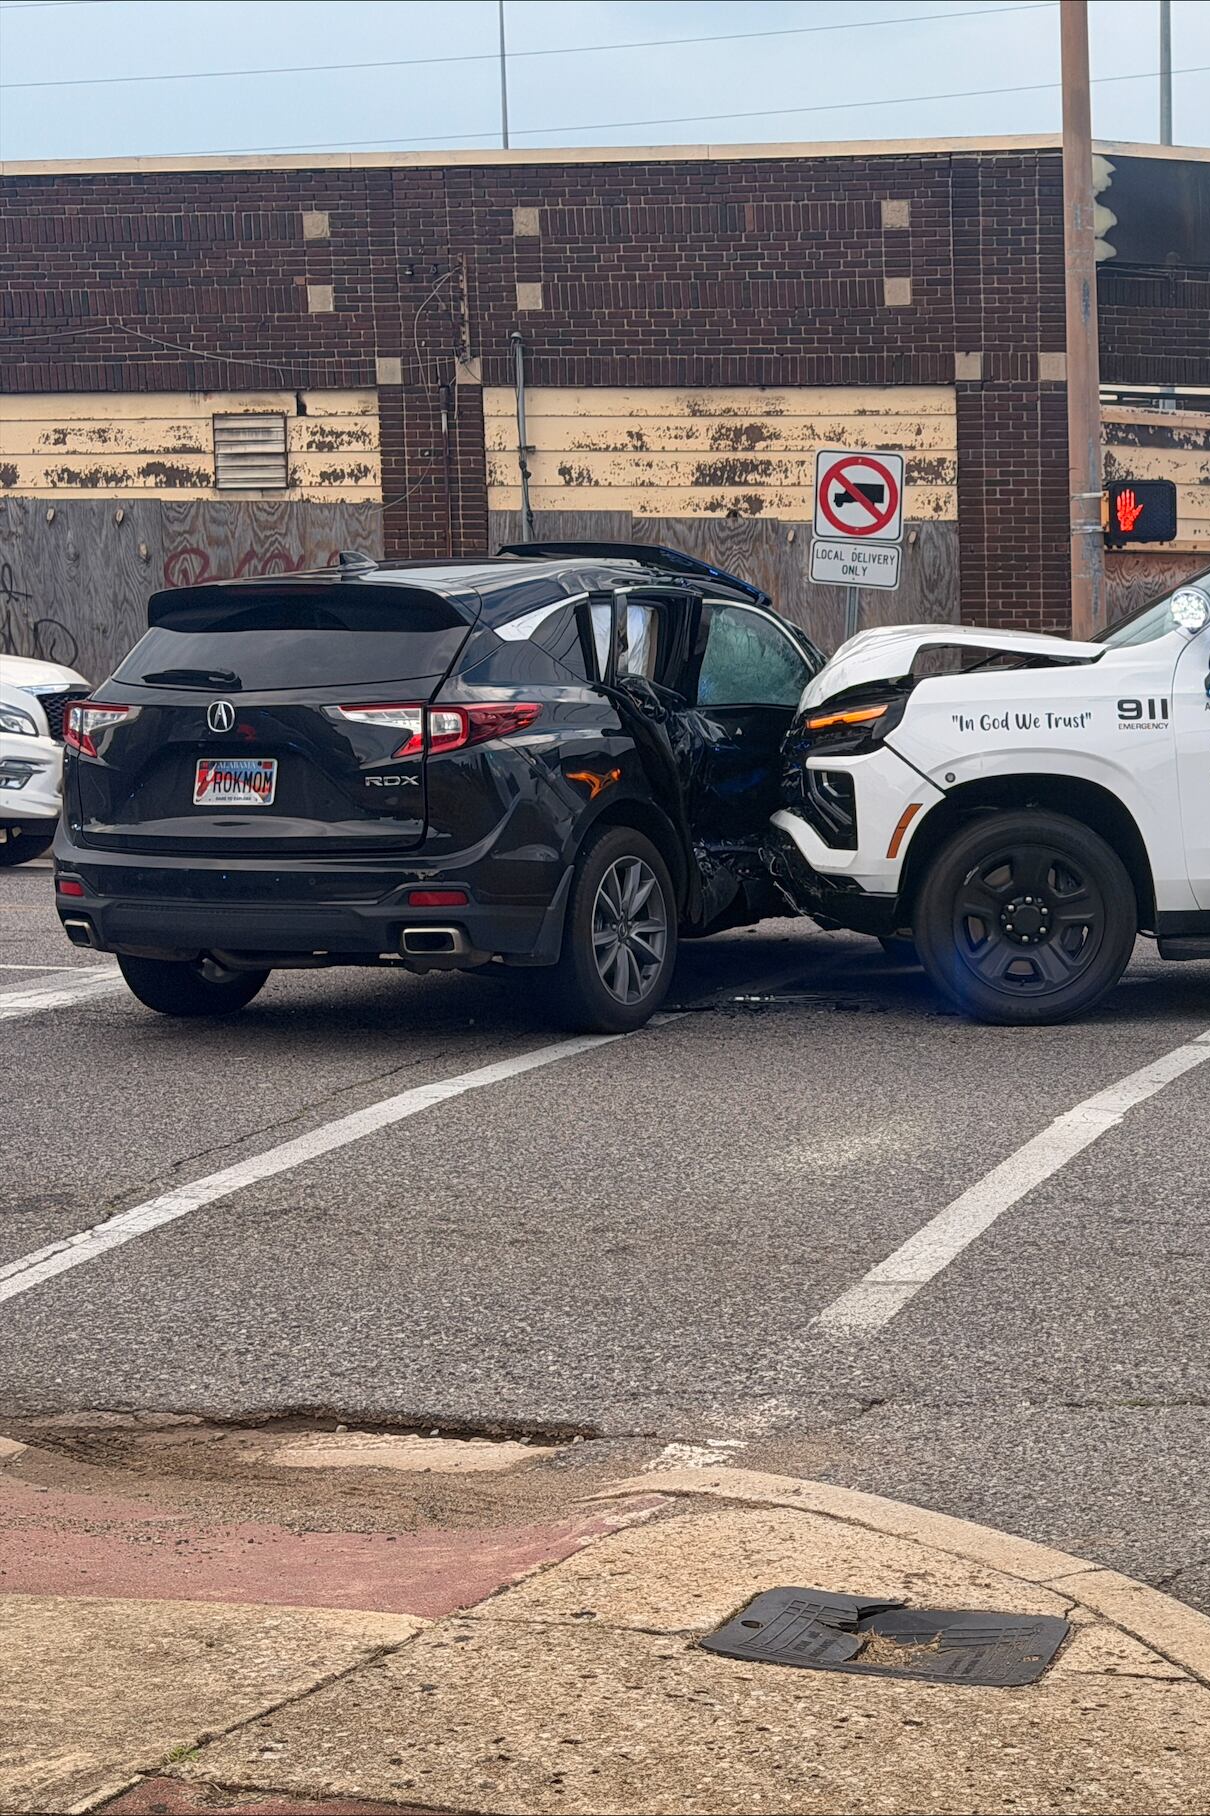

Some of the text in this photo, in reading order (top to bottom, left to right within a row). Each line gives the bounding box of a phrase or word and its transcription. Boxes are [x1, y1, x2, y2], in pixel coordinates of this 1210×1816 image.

[816, 548, 896, 566] LOCAL DELIVERY
[841, 564, 868, 576] ONLY
[1117, 698, 1169, 721] 911
[952, 711, 1092, 732] "In God We Trust"
[1118, 722, 1169, 730] EMERGENCY
[217, 761, 257, 769] ALABAMA
[212, 771, 273, 793] ROKMOM
[365, 775, 419, 786] RDX
